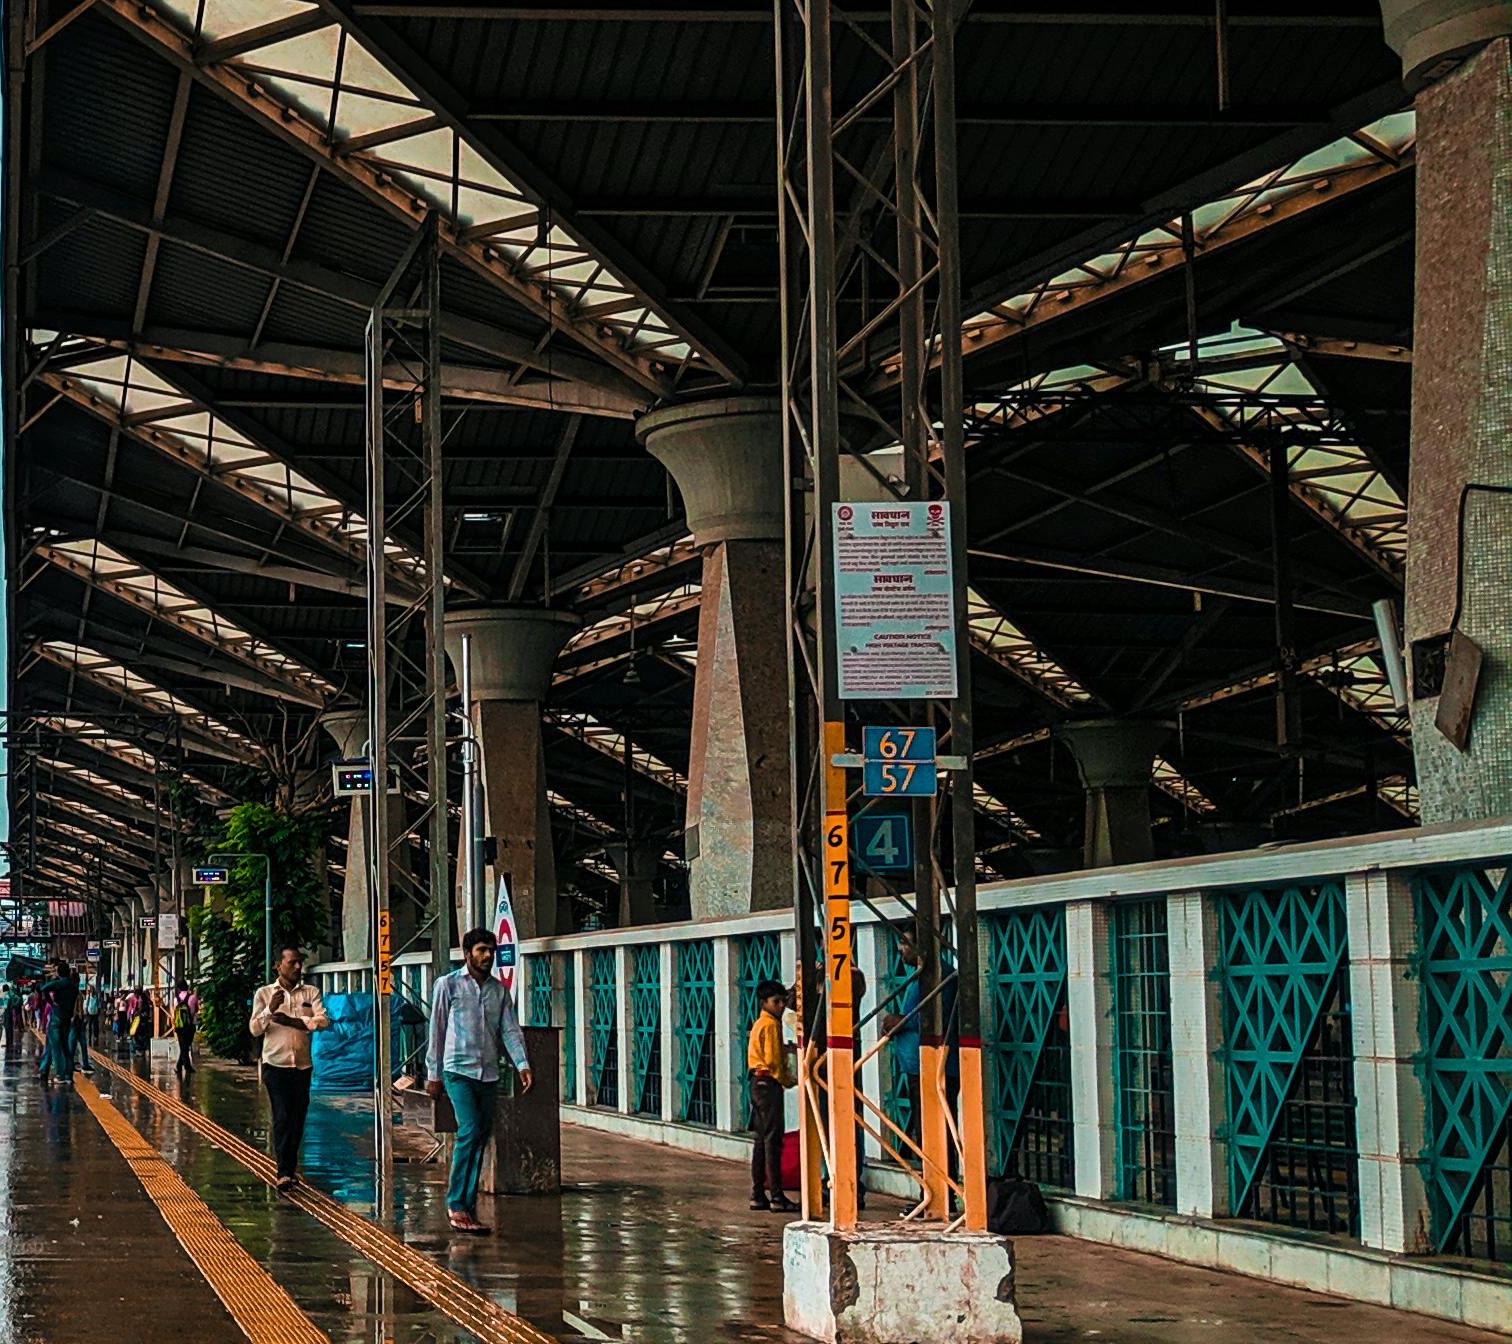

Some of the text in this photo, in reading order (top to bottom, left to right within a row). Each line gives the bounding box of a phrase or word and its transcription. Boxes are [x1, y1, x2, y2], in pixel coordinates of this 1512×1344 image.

[879, 731, 916, 759] 67
[881, 764, 916, 793] 57
[866, 819, 899, 865] 4
